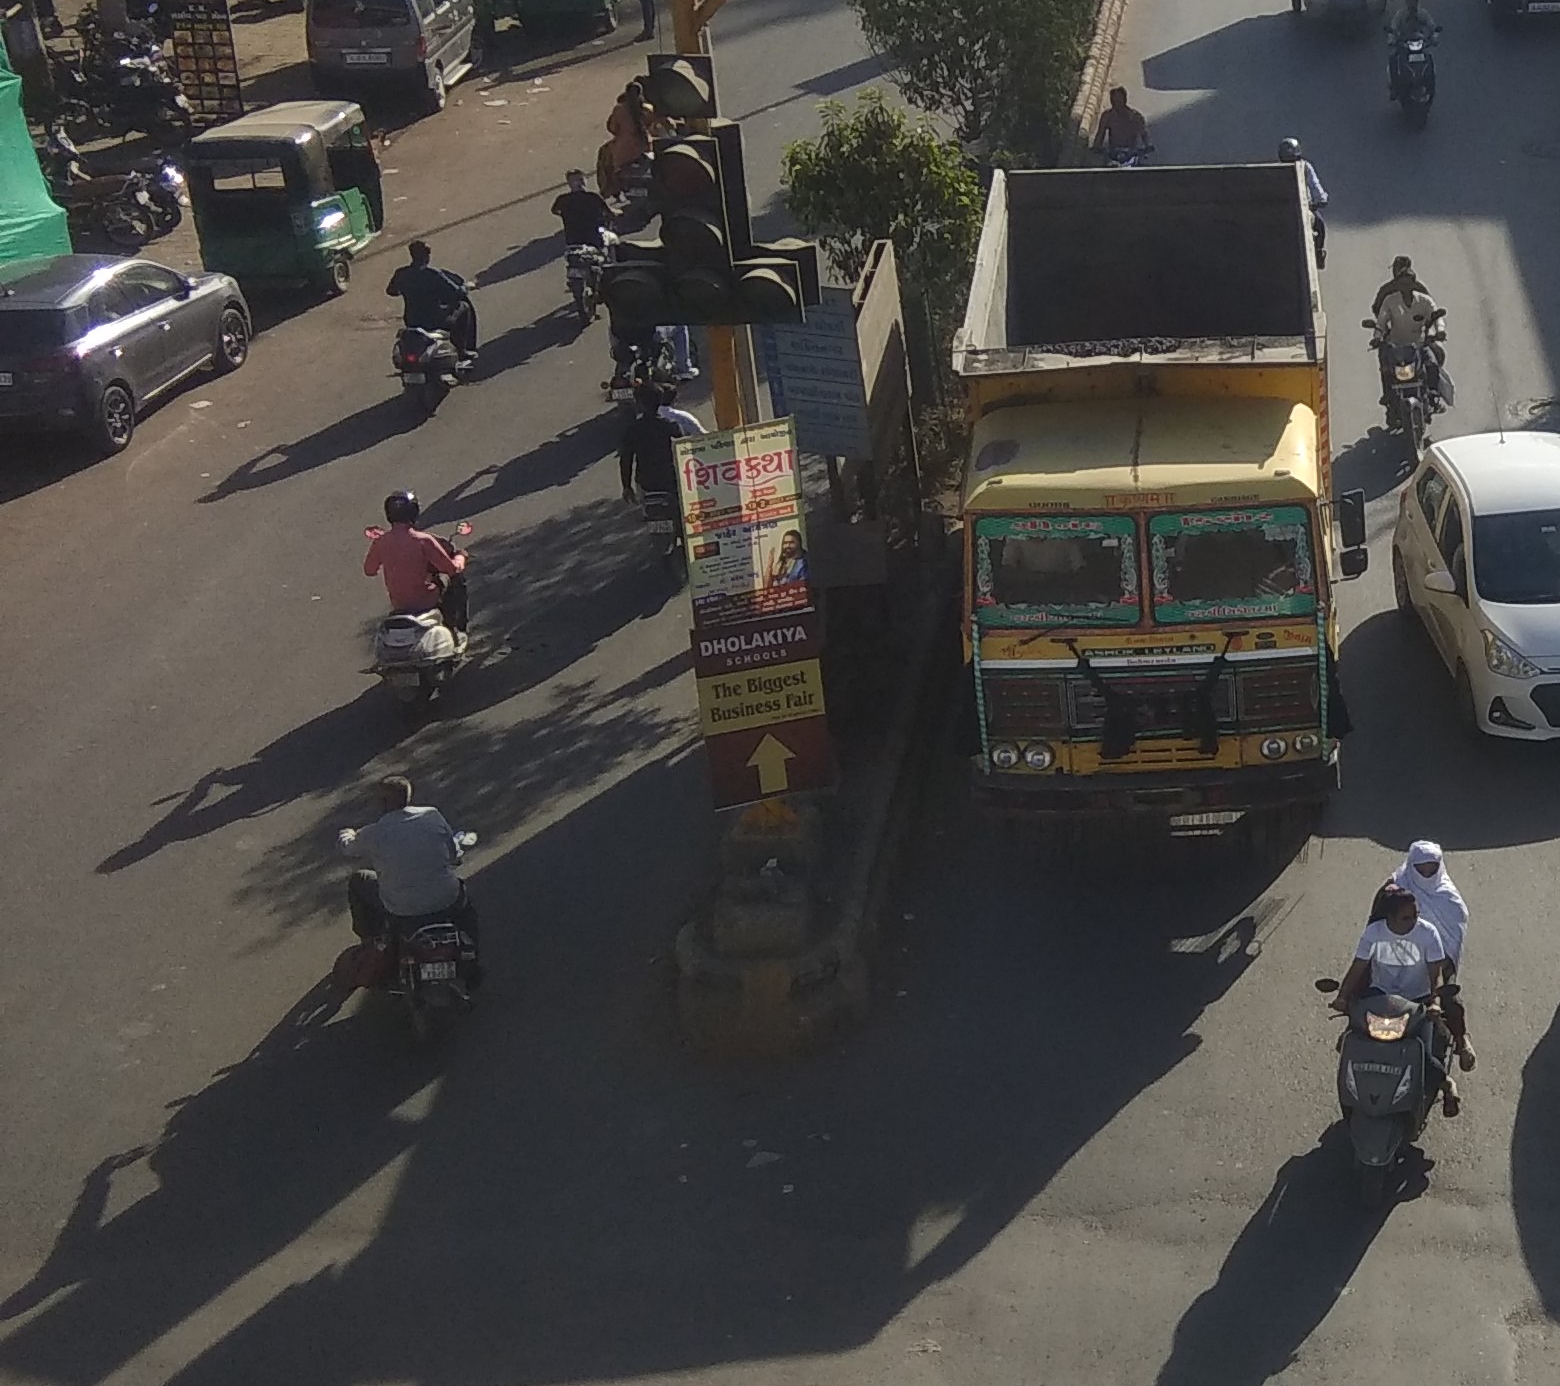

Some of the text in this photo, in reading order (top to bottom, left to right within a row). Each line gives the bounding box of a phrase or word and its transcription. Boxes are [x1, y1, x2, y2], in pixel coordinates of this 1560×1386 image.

[699, 624, 808, 658] DHOLAKIYA
[726, 649, 788, 666] SCHOOLS
[712, 671, 807, 700] The Biggest
[710, 698, 781, 723] Business
[786, 690, 815, 709] Fair
